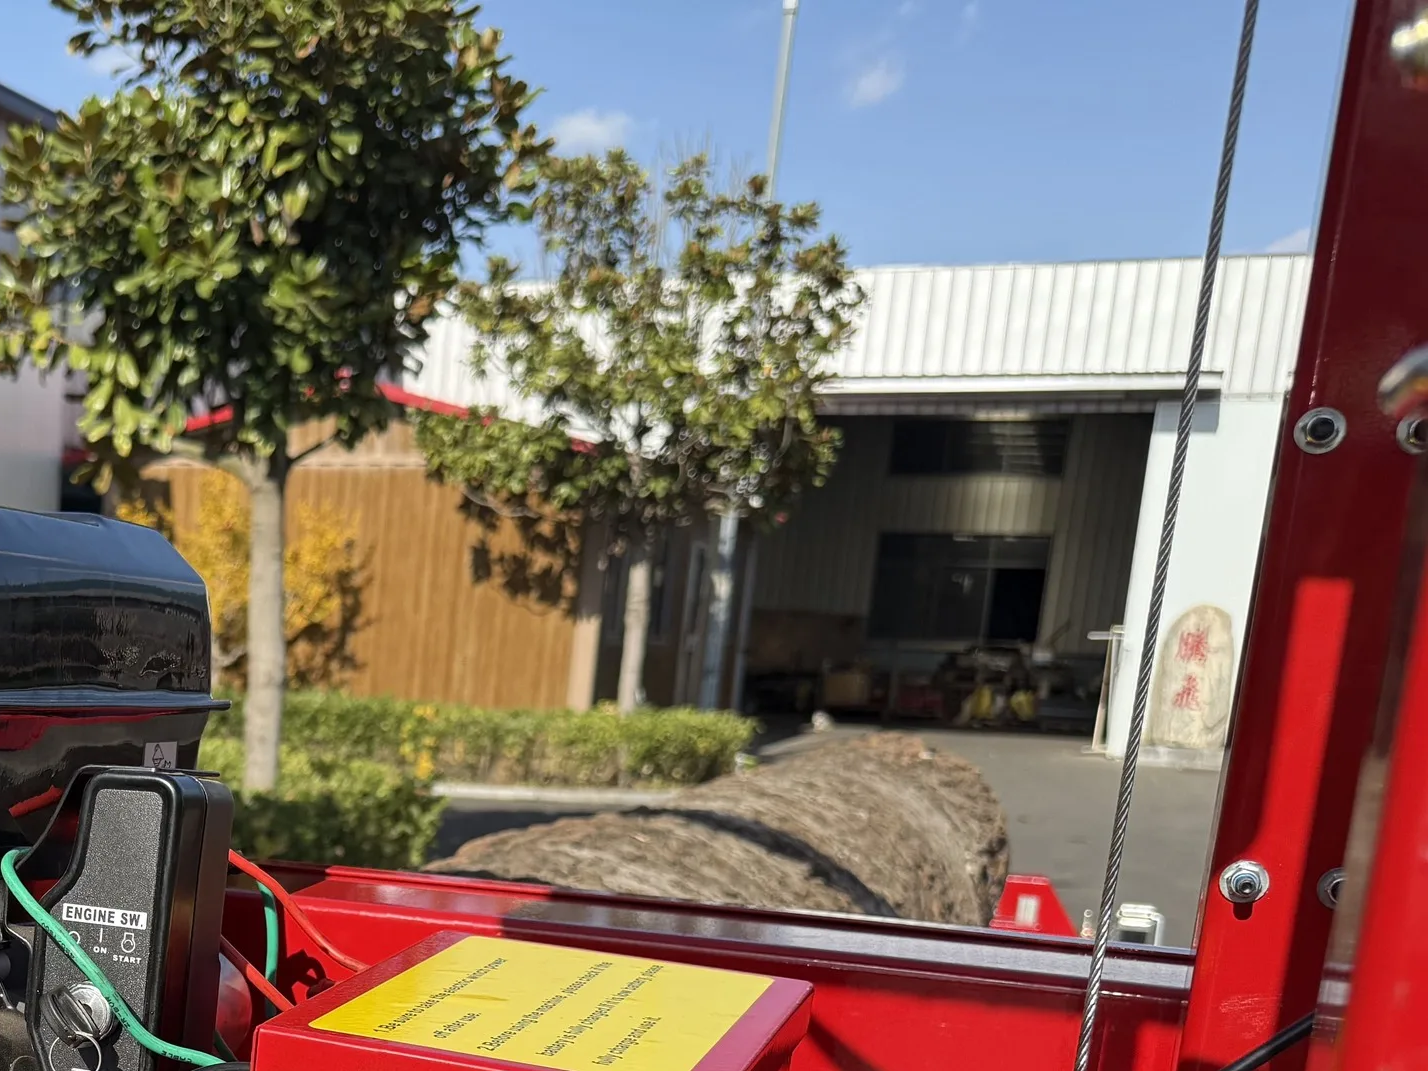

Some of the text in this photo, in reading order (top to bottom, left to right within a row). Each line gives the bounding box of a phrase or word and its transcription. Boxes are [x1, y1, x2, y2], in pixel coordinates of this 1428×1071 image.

[65, 905, 144, 928] ENGINE SW.
[93, 946, 107, 954] ON
[112, 954, 142, 964] START
[577, 970, 600, 981] check
[392, 1012, 417, 1023] sure
[415, 999, 440, 1008] take
[442, 978, 473, 993] electric
[466, 968, 490, 979] winch
[483, 957, 507, 969] power
[560, 980, 586, 994] please
[522, 1011, 544, 1019] the
[536, 1038, 574, 1056] battery
[563, 1023, 593, 1034] fully
[640, 964, 663, 977] please
[432, 1012, 481, 1038] off after use.
[508, 1018, 538, 1031] using
[637, 1020, 656, 1029] use
[627, 1027, 647, 1038] and
[476, 1030, 516, 1051] 2.Before
[607, 1037, 639, 1054] charge
[592, 1053, 623, 1065] fully
